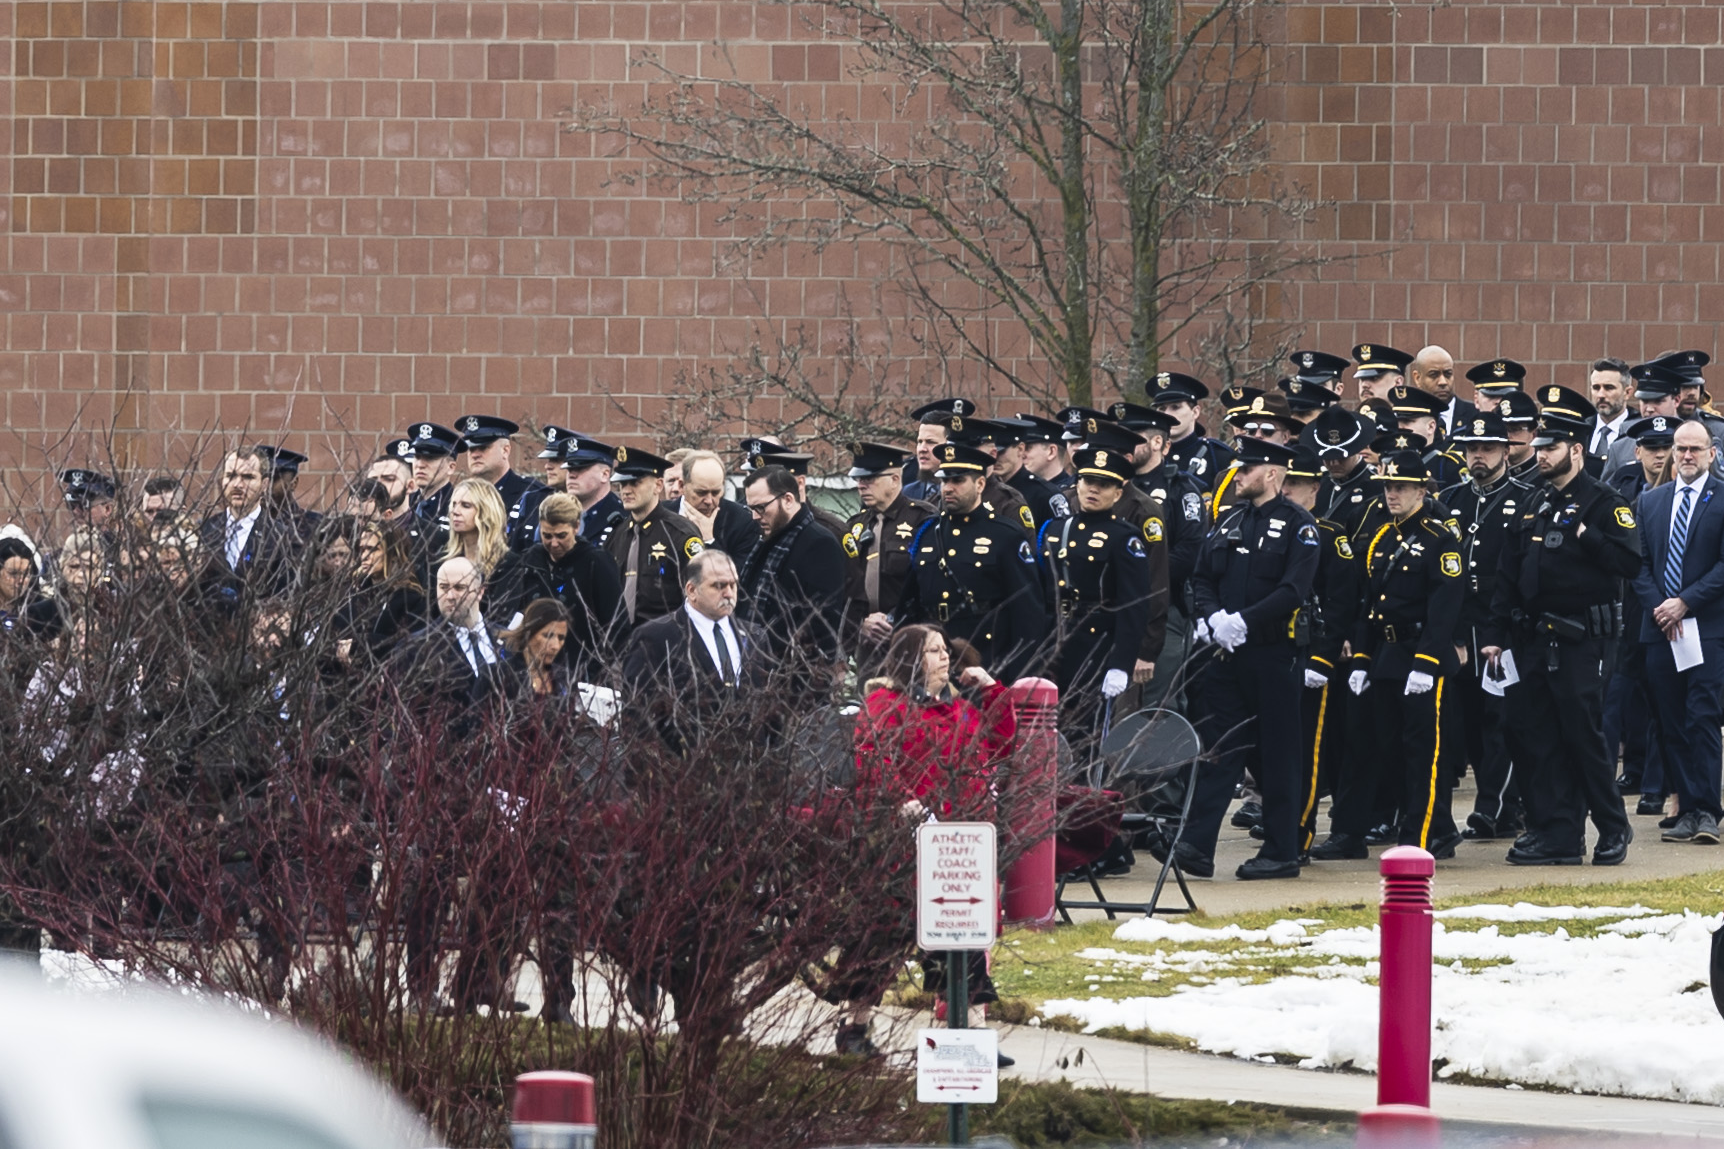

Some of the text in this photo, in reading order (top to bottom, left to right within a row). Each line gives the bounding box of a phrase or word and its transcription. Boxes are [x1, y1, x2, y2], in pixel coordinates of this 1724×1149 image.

[932, 834, 982, 844] ATHLETIC
[938, 846, 975, 856] STAFF/
[937, 859, 977, 869] COACH
[932, 871, 981, 881] PARKING
[941, 883, 971, 893] ONLY
